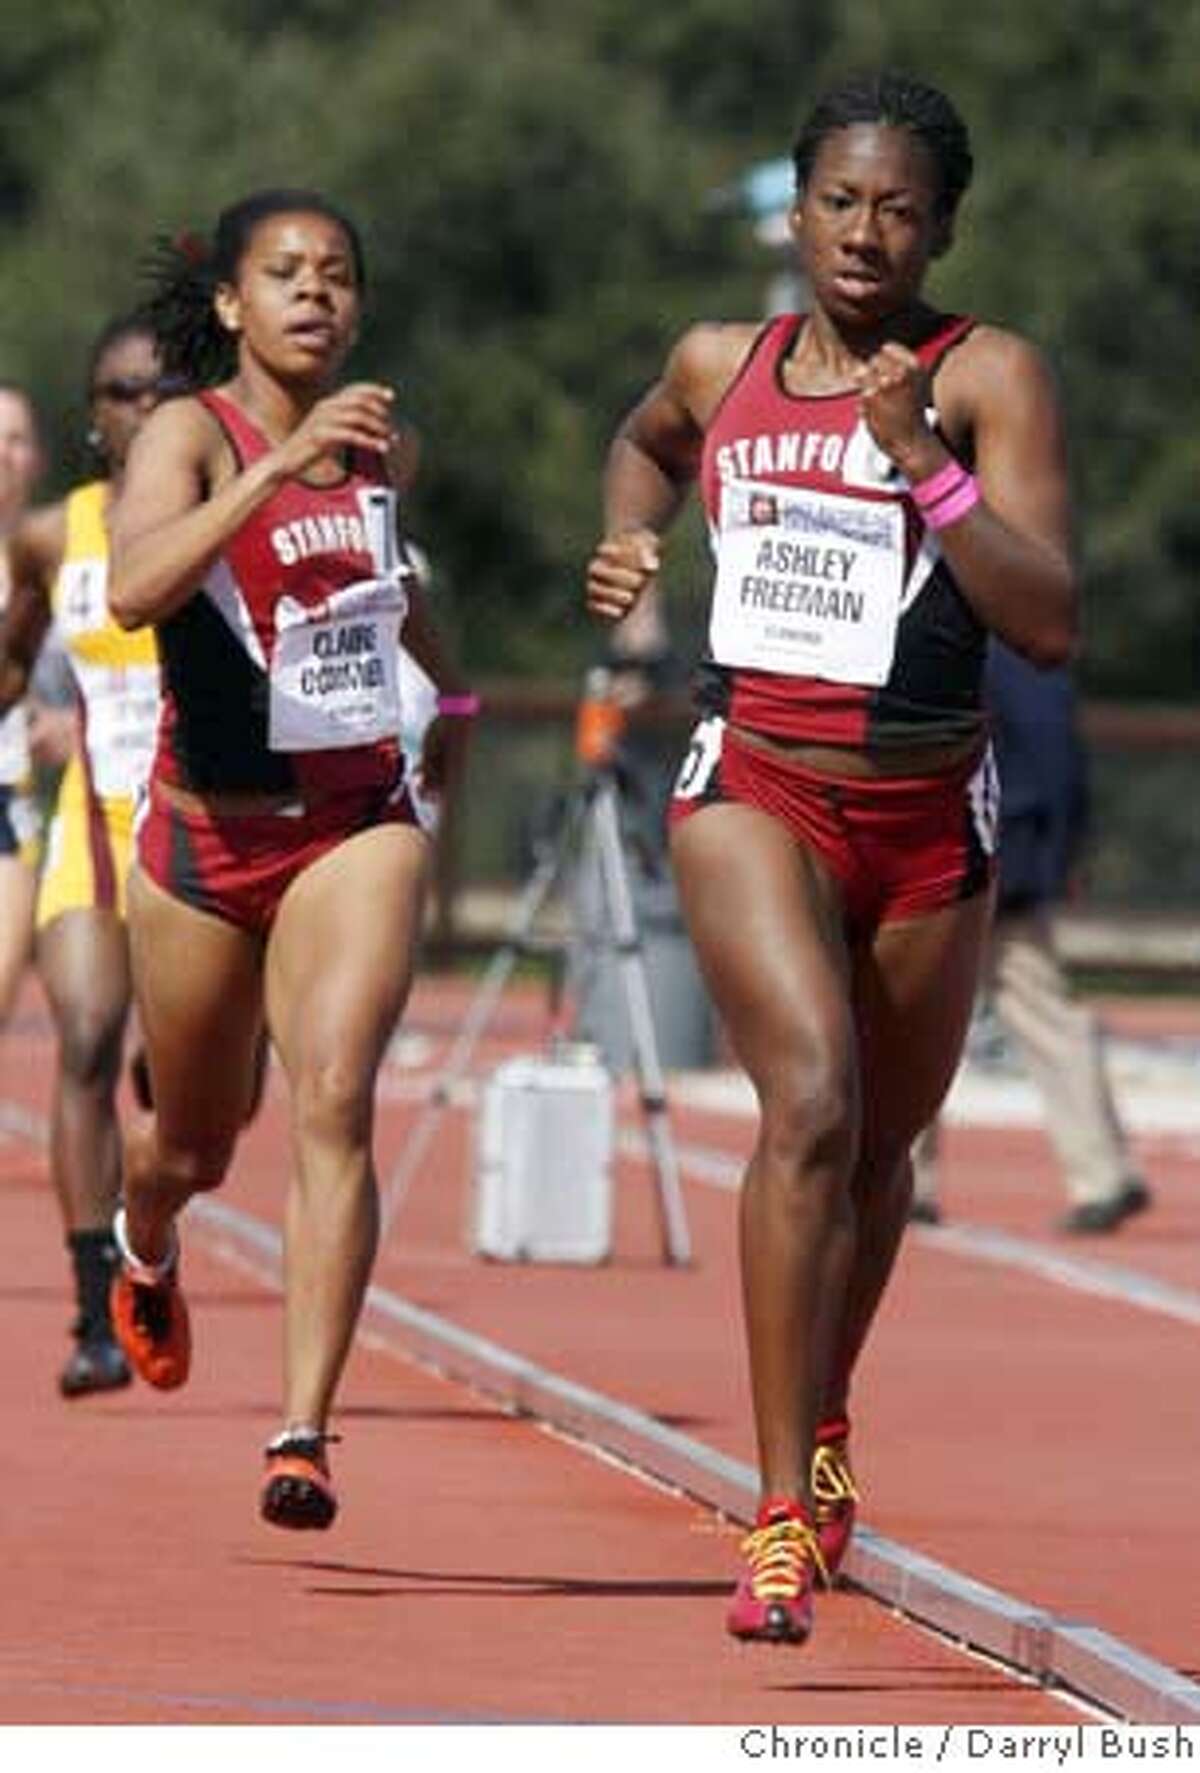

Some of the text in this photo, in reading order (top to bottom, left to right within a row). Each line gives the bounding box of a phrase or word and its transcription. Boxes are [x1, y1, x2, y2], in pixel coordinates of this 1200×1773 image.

[716, 432, 844, 482] STANFO
[756, 538, 857, 582] ASHLEY
[740, 575, 865, 624] FREEMAN
